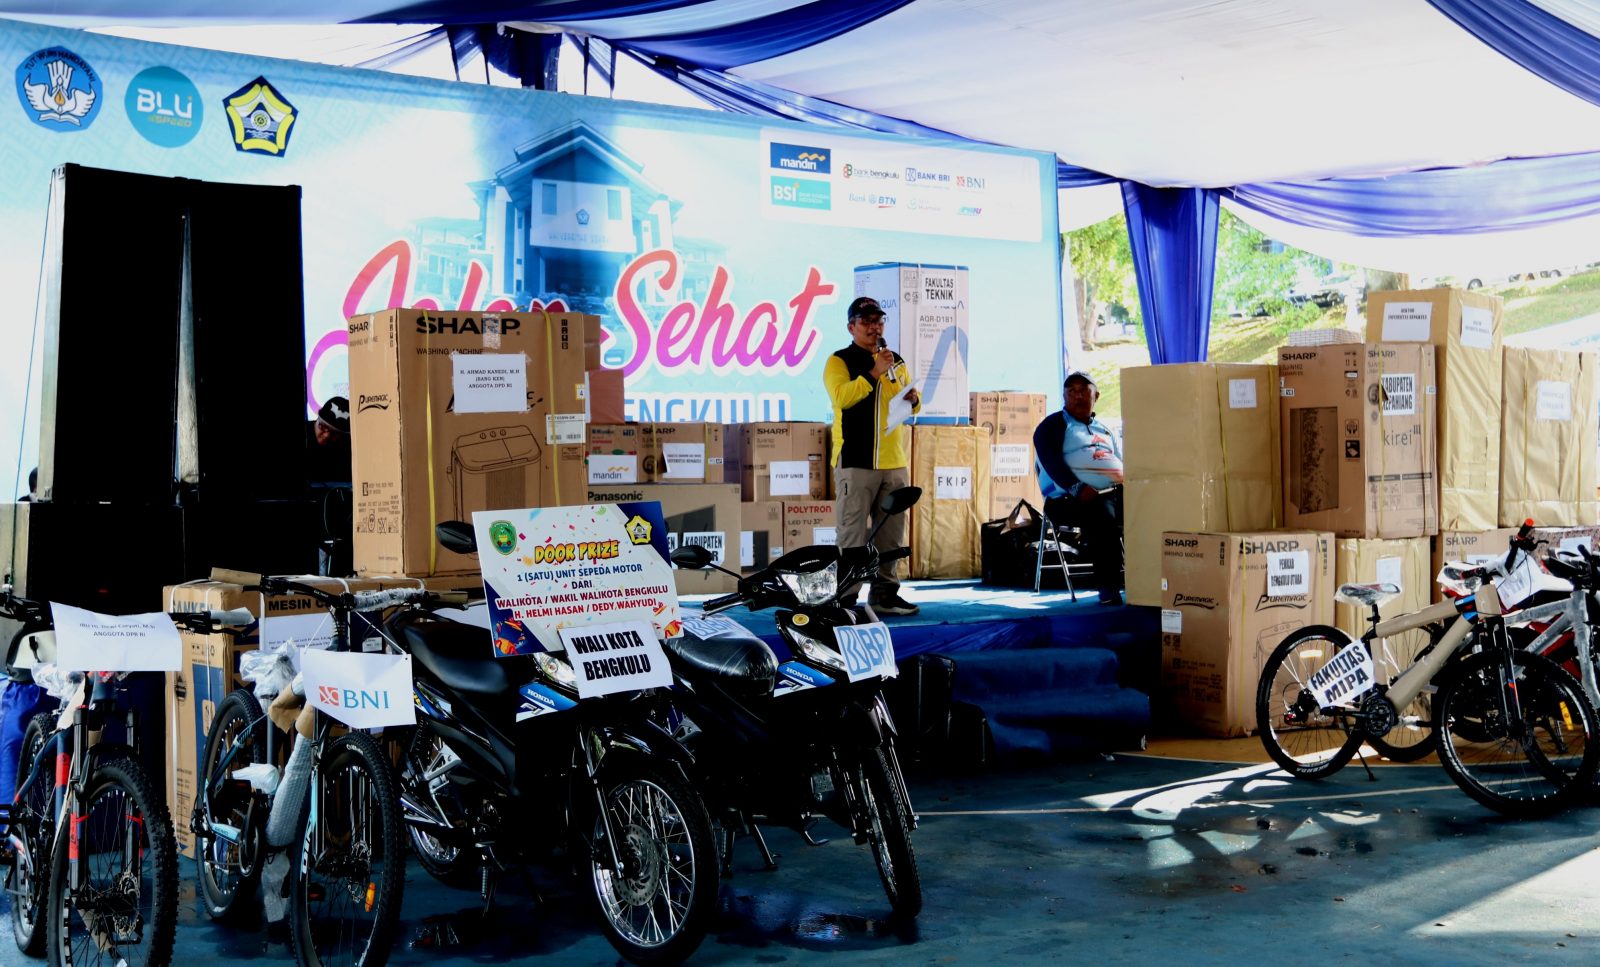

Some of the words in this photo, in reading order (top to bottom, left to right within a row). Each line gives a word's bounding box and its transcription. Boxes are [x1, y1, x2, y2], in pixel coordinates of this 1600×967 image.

[137, 88, 192, 119] BLU
[917, 172, 937, 181] BANK
[939, 174, 950, 182] BRI
[966, 177, 985, 189] BNI
[773, 183, 799, 202] BSI
[925, 278, 953, 288] FAKULTAS
[926, 289, 953, 300] TEKNIK
[602, 249, 834, 370] Sehat
[881, 299, 897, 309] QUA
[350, 321, 369, 334] SHAR
[416, 317, 521, 335] SHARP
[1384, 430, 1412, 446] kirei
[593, 471, 622, 480] mandiri
[588, 491, 642, 501] Panasonic
[535, 543, 575, 564] DOOR
[578, 540, 620, 560] PRIZE
[1164, 539, 1198, 548] SHARP
[1239, 540, 1299, 555] SHARP
[517, 574, 522, 582] 1
[525, 570, 554, 582] (SATU)
[556, 568, 576, 579] UNIT
[578, 566, 611, 577] SEPEDA
[613, 563, 643, 574] MOTOR
[572, 580, 593, 590] DARI
[268, 599, 312, 611] MESIN
[497, 597, 543, 609] WALIKOTA
[550, 593, 579, 604] WAKIL
[580, 589, 623, 601] WALIKOTA
[625, 585, 669, 596] BENGKULU
[526, 608, 553, 618] HELMI
[555, 605, 584, 616] HASAN
[592, 602, 615, 612] DEDY
[616, 598, 657, 610] WAHYUDI
[571, 634, 609, 654] WALI
[610, 630, 645, 650] KOTA
[583, 654, 652, 680] BENGKULU
[786, 667, 814, 683] HONDA
[1311, 646, 1365, 690] FAKULTAS
[1324, 667, 1369, 704] MIPA
[343, 689, 389, 709] BNI
[527, 688, 555, 706] HONDA
